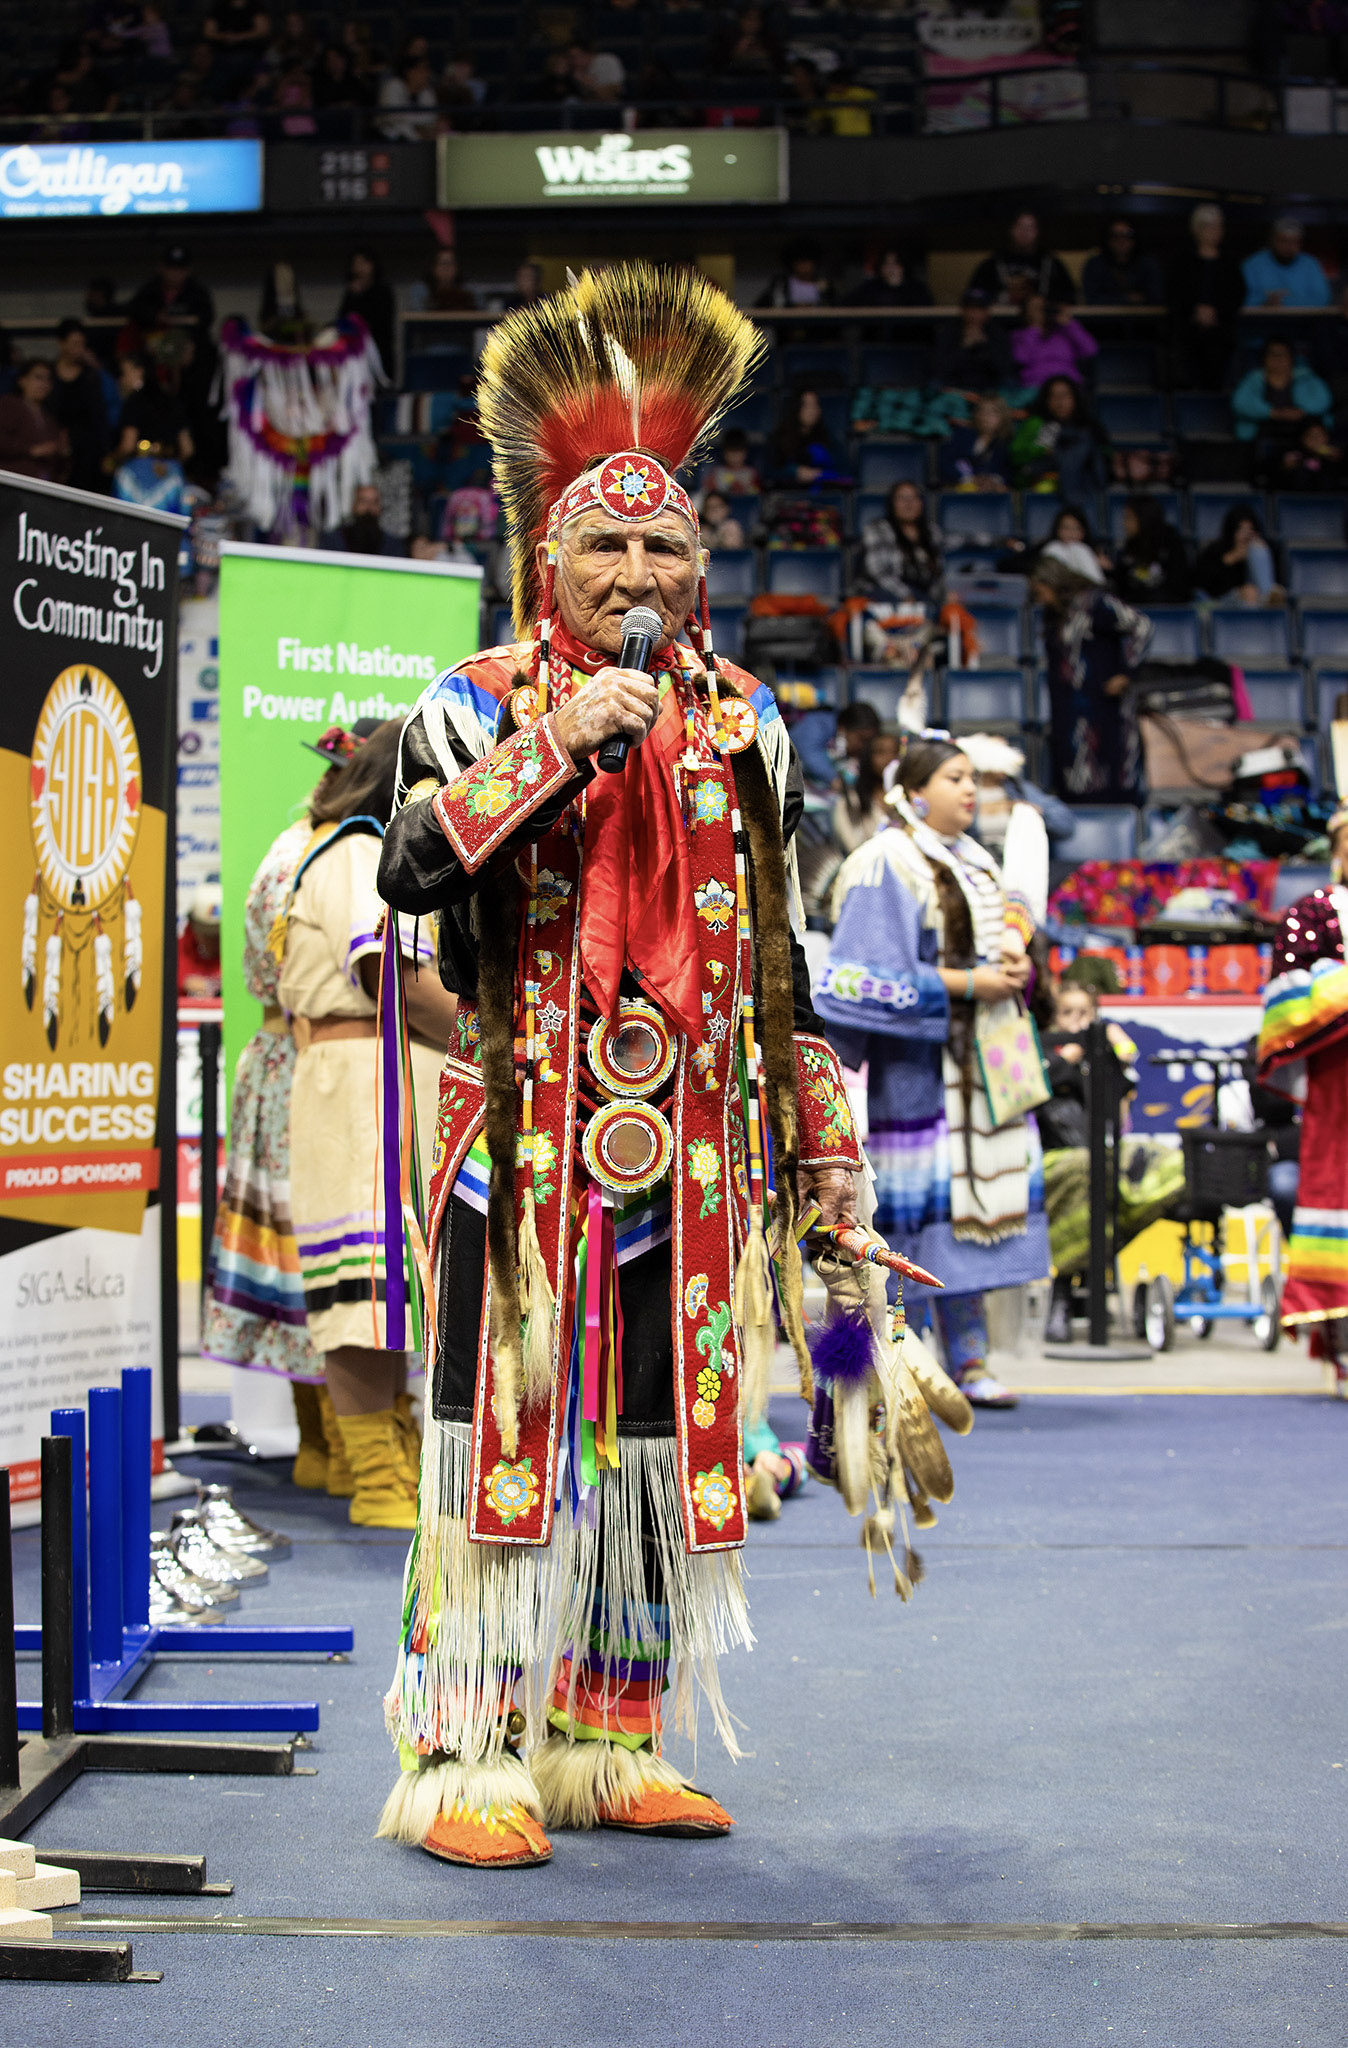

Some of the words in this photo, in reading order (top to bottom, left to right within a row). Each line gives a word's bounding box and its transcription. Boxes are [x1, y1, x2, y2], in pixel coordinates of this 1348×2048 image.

[0, 145, 184, 215] Culligan
[17, 512, 138, 608] Investing
[141, 541, 165, 591] In
[13, 578, 163, 678] Community
[278, 636, 333, 673] First
[336, 641, 436, 680] Nations
[242, 685, 325, 722] Power
[3, 1061, 154, 1100] SHARING
[0, 1103, 156, 1146] SUCCESS
[5, 1166, 59, 1189] PROUD
[60, 1162, 142, 1184] SPONSOR
